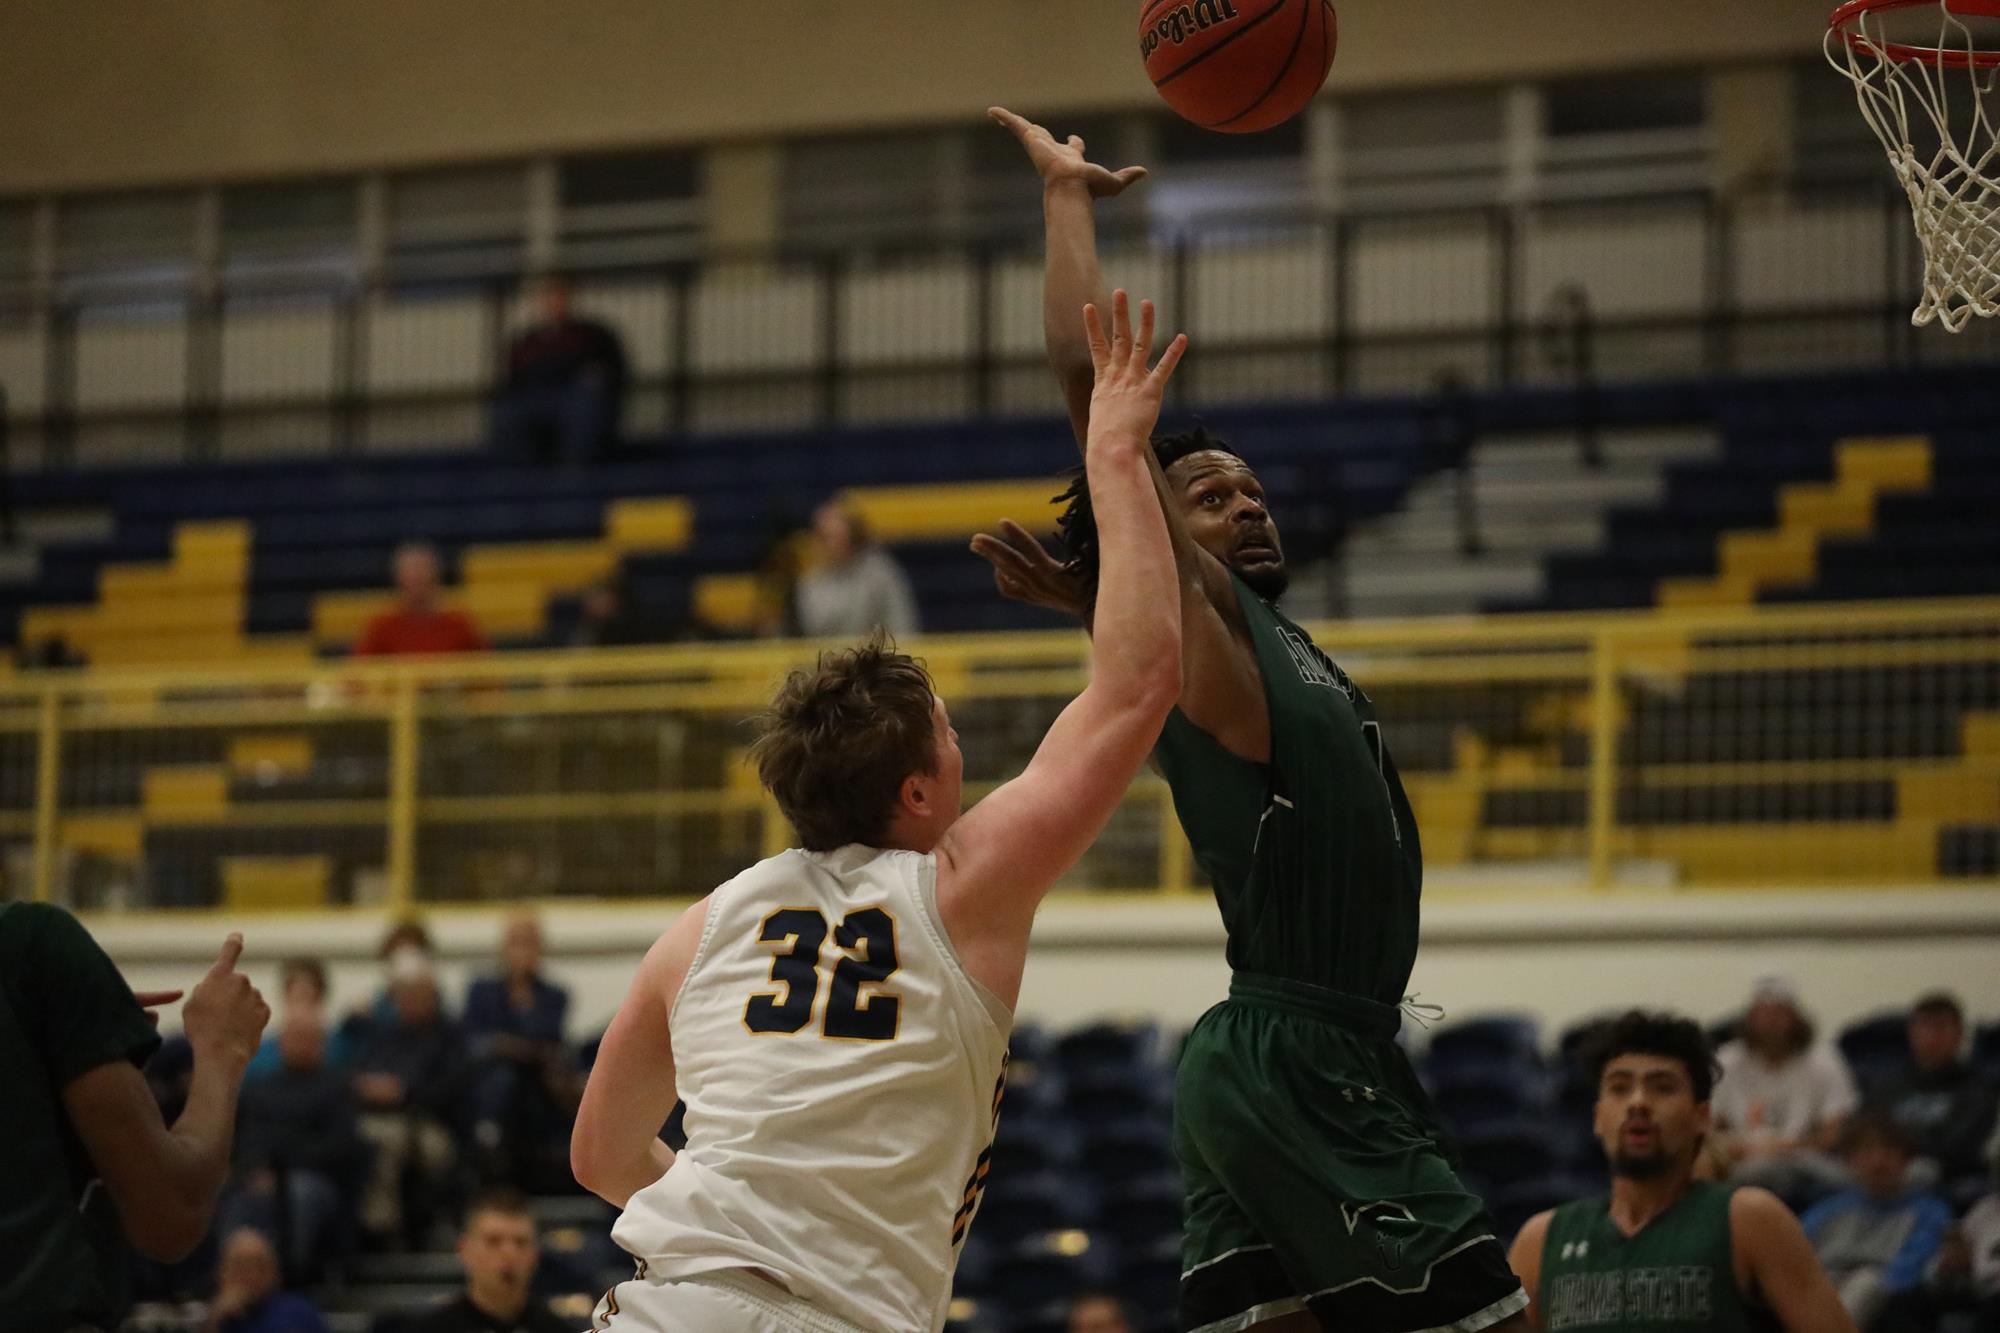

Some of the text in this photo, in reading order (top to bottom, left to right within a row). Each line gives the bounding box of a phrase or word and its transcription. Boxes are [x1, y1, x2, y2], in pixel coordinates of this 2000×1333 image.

[1140, 0, 1239, 63] Wilson
[742, 905, 902, 1041] 32
[1625, 1265, 1714, 1322] STATE
